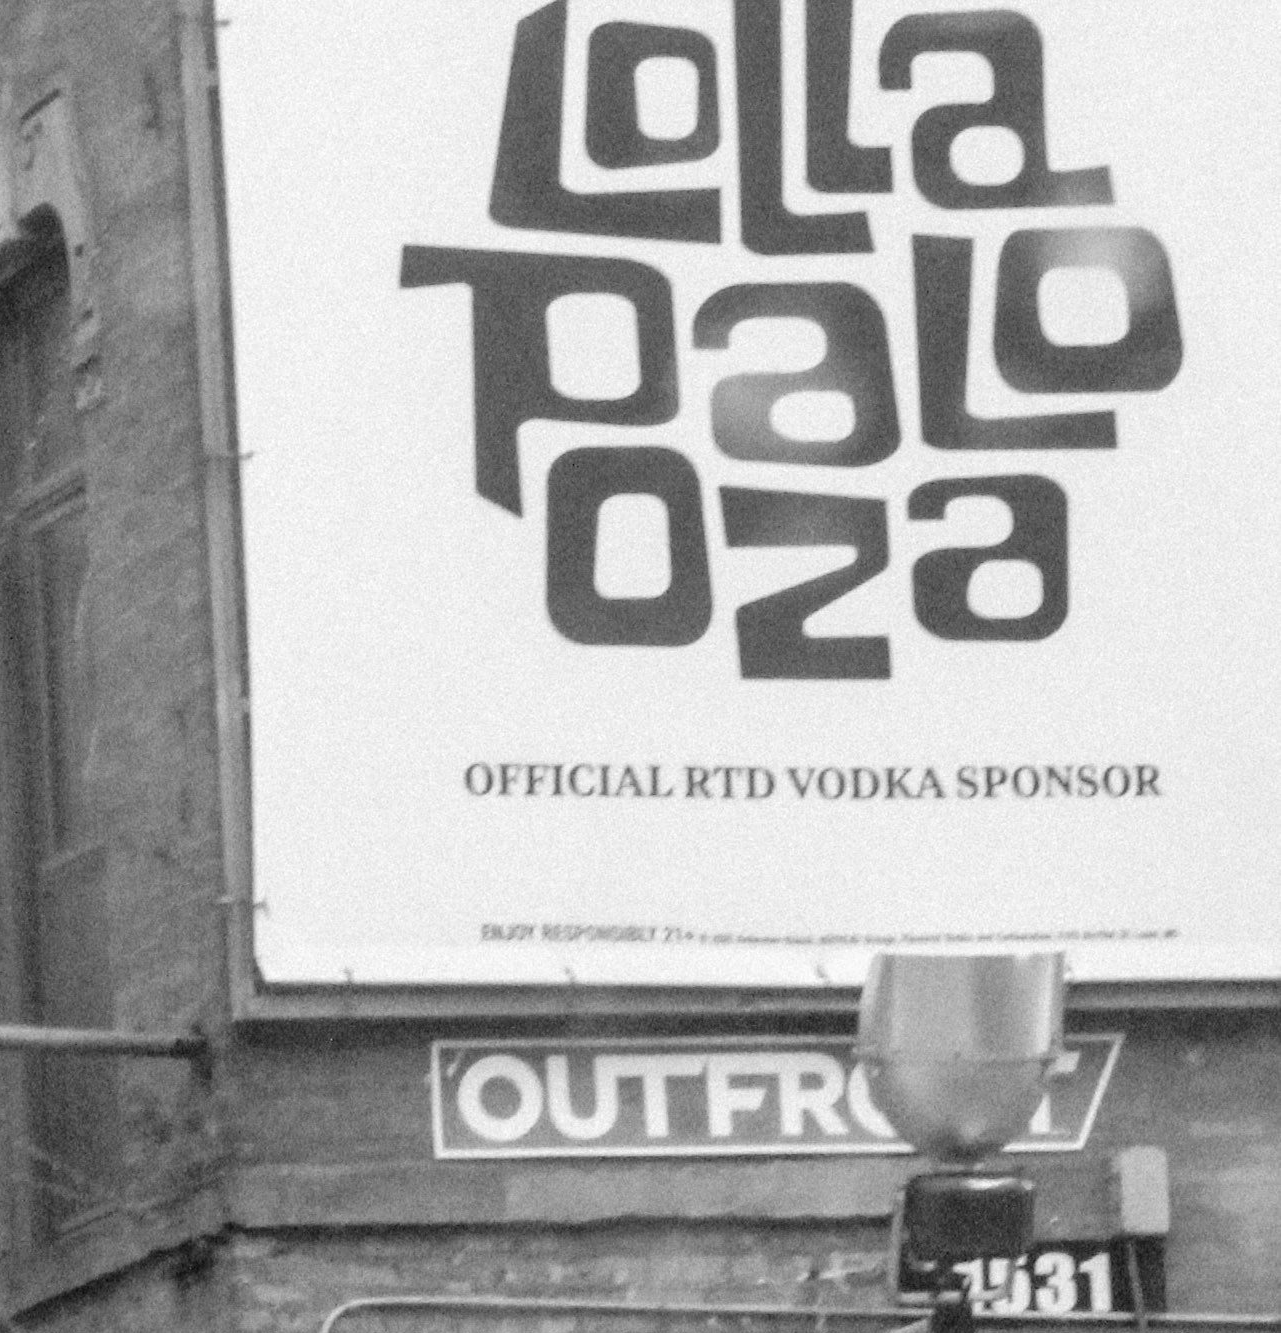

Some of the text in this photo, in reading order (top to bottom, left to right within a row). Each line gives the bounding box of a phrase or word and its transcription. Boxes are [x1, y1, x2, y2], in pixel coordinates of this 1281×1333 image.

[464, 762, 1162, 800] OFFICIAL RTD VODKA SPONSOR
[457, 1052, 1081, 1140] OUTFR
